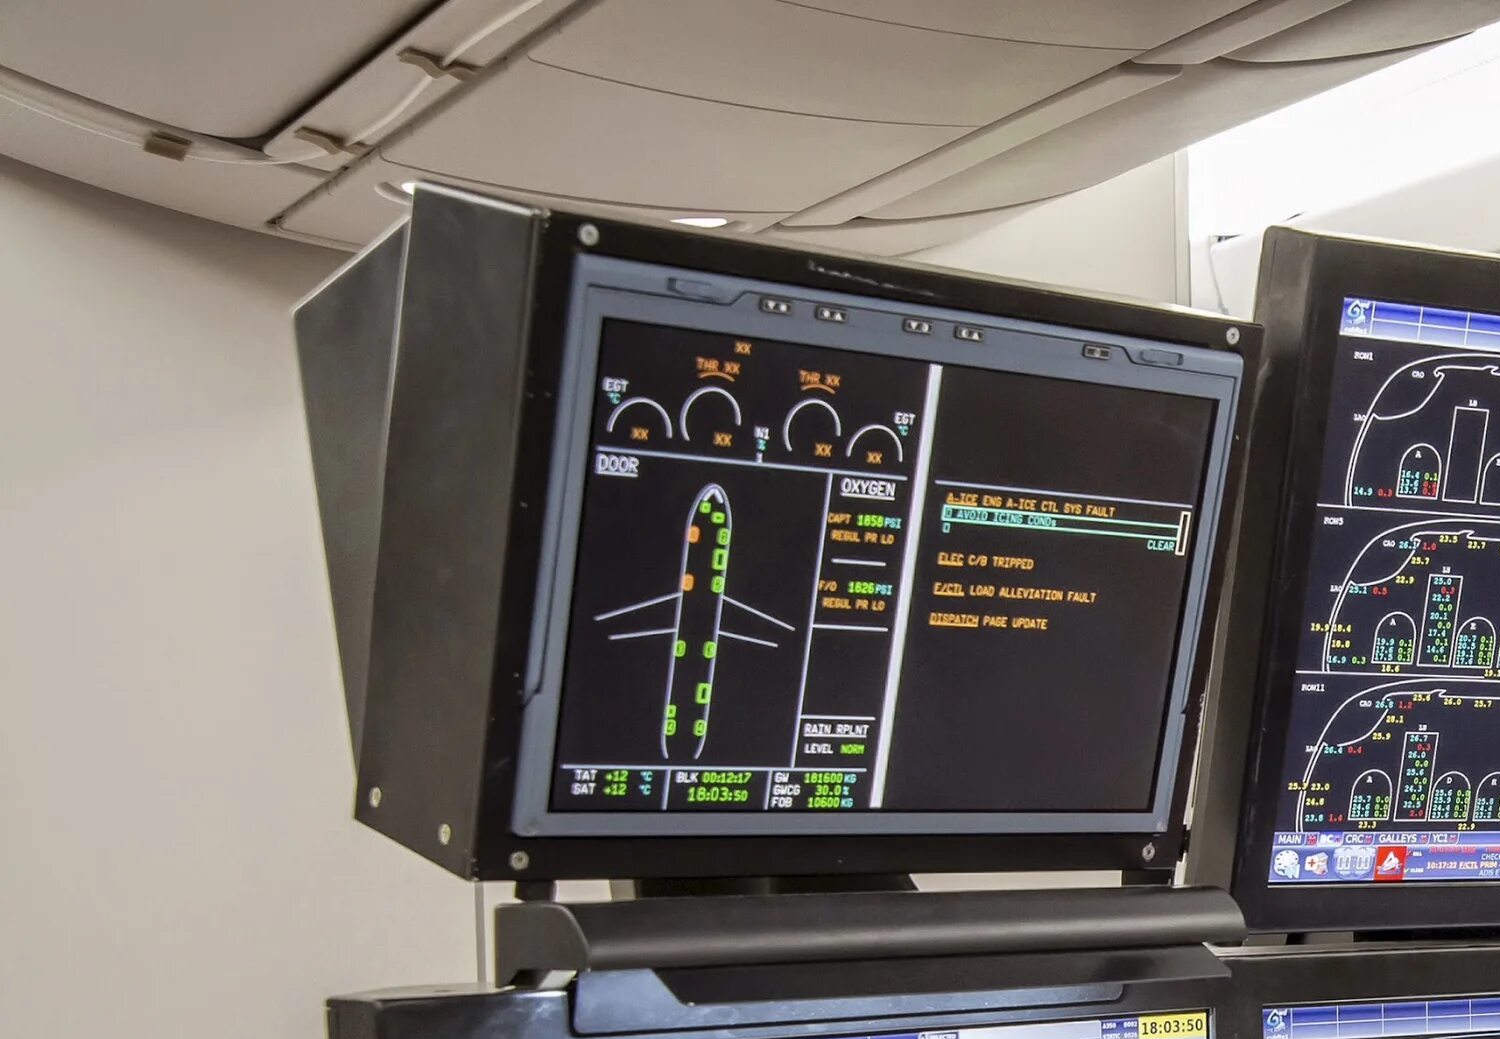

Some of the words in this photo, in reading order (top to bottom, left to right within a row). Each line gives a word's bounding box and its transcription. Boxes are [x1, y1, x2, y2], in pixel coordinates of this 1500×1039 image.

[696, 357, 723, 372] THR
[800, 369, 822, 384] THR
[602, 377, 629, 392] EGT
[894, 412, 915, 426] EGT
[597, 454, 639, 473] DOOR
[841, 480, 896, 497] OXYGEN
[946, 492, 978, 506] A-ICE
[982, 495, 1001, 506] ENG
[1006, 498, 1036, 510] A-ICE
[1041, 502, 1058, 512] CTL
[1064, 504, 1082, 514] SYS
[1086, 506, 1115, 518] FAULT
[828, 513, 852, 523] CAPT
[958, 510, 988, 521] AVOID
[992, 514, 1023, 524] ICING
[864, 532, 878, 543] PR
[881, 534, 894, 544] LO
[1147, 540, 1175, 551] CLEAR
[938, 552, 964, 566] ELEC
[968, 555, 987, 566] C/B
[993, 556, 1034, 569] TRIPPED
[934, 582, 964, 595] F/CTL
[970, 584, 995, 596] LOAD
[1000, 587, 1063, 600] ALLEVIATION
[1067, 591, 1096, 602] FAULT
[856, 599, 868, 610] PR
[872, 601, 885, 611] LO
[930, 612, 978, 627] DISPATCH
[983, 616, 1008, 628] PAGE
[1012, 618, 1048, 630] UPDATE
[804, 724, 831, 735] RAIN
[836, 725, 868, 736] RPLNT
[805, 744, 833, 754] LEVEL
[840, 745, 864, 754] NORM
[573, 770, 597, 781] TAT
[605, 771, 628, 782] +12
[676, 773, 698, 783] BLK
[702, 773, 751, 783] 00:12:17
[775, 773, 789, 782] GW
[571, 783, 596, 794] SAT
[604, 784, 626, 795] +12
[688, 788, 748, 801] 18:03:50
[773, 785, 800, 795] GWCG
[771, 798, 792, 807] FOB
[1278, 835, 1301, 843] MAIN
[1379, 835, 1417, 843] GALLEYS
[1142, 1019, 1203, 1035] 18:03:50
